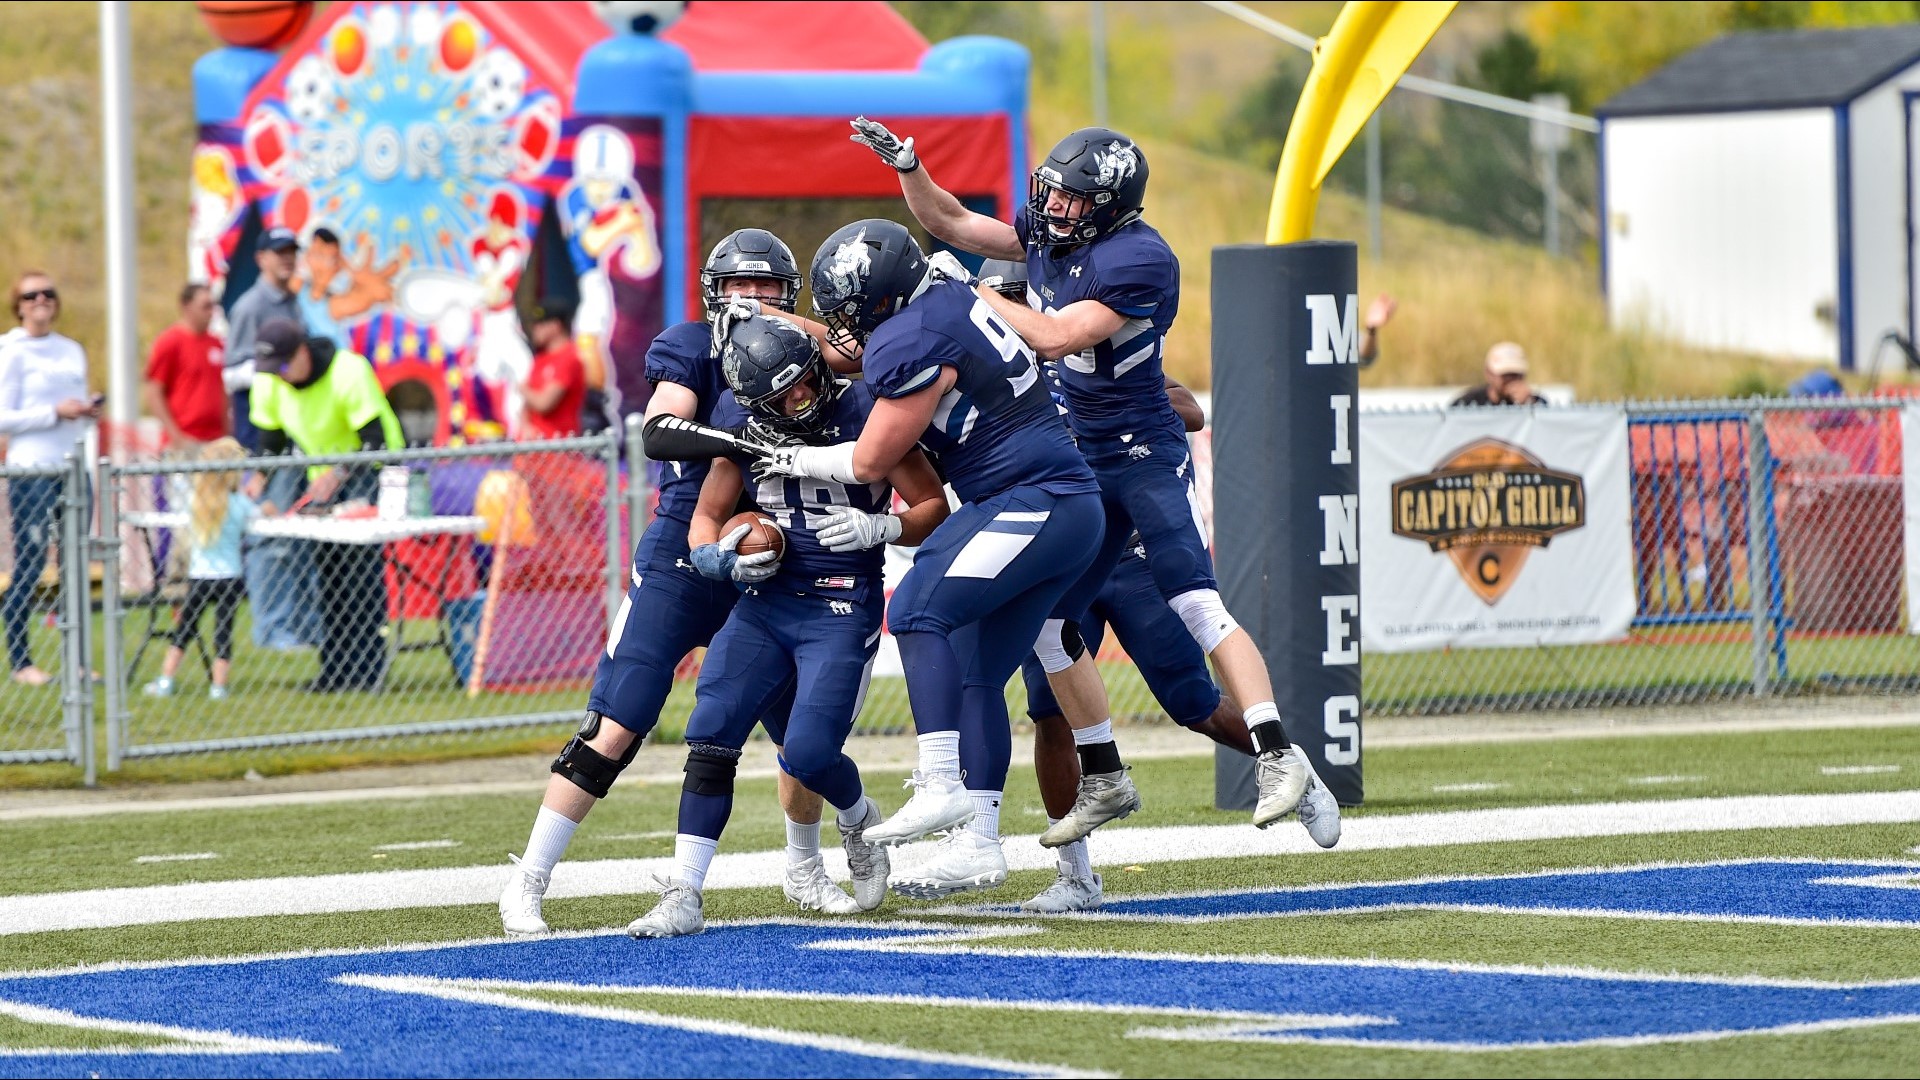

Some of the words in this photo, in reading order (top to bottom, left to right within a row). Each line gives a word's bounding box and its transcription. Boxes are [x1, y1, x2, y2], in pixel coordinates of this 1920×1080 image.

[1306, 294, 1359, 766] MINES
[1400, 487, 1502, 531] CAPITOL
[1506, 485, 1577, 526] GRILL
